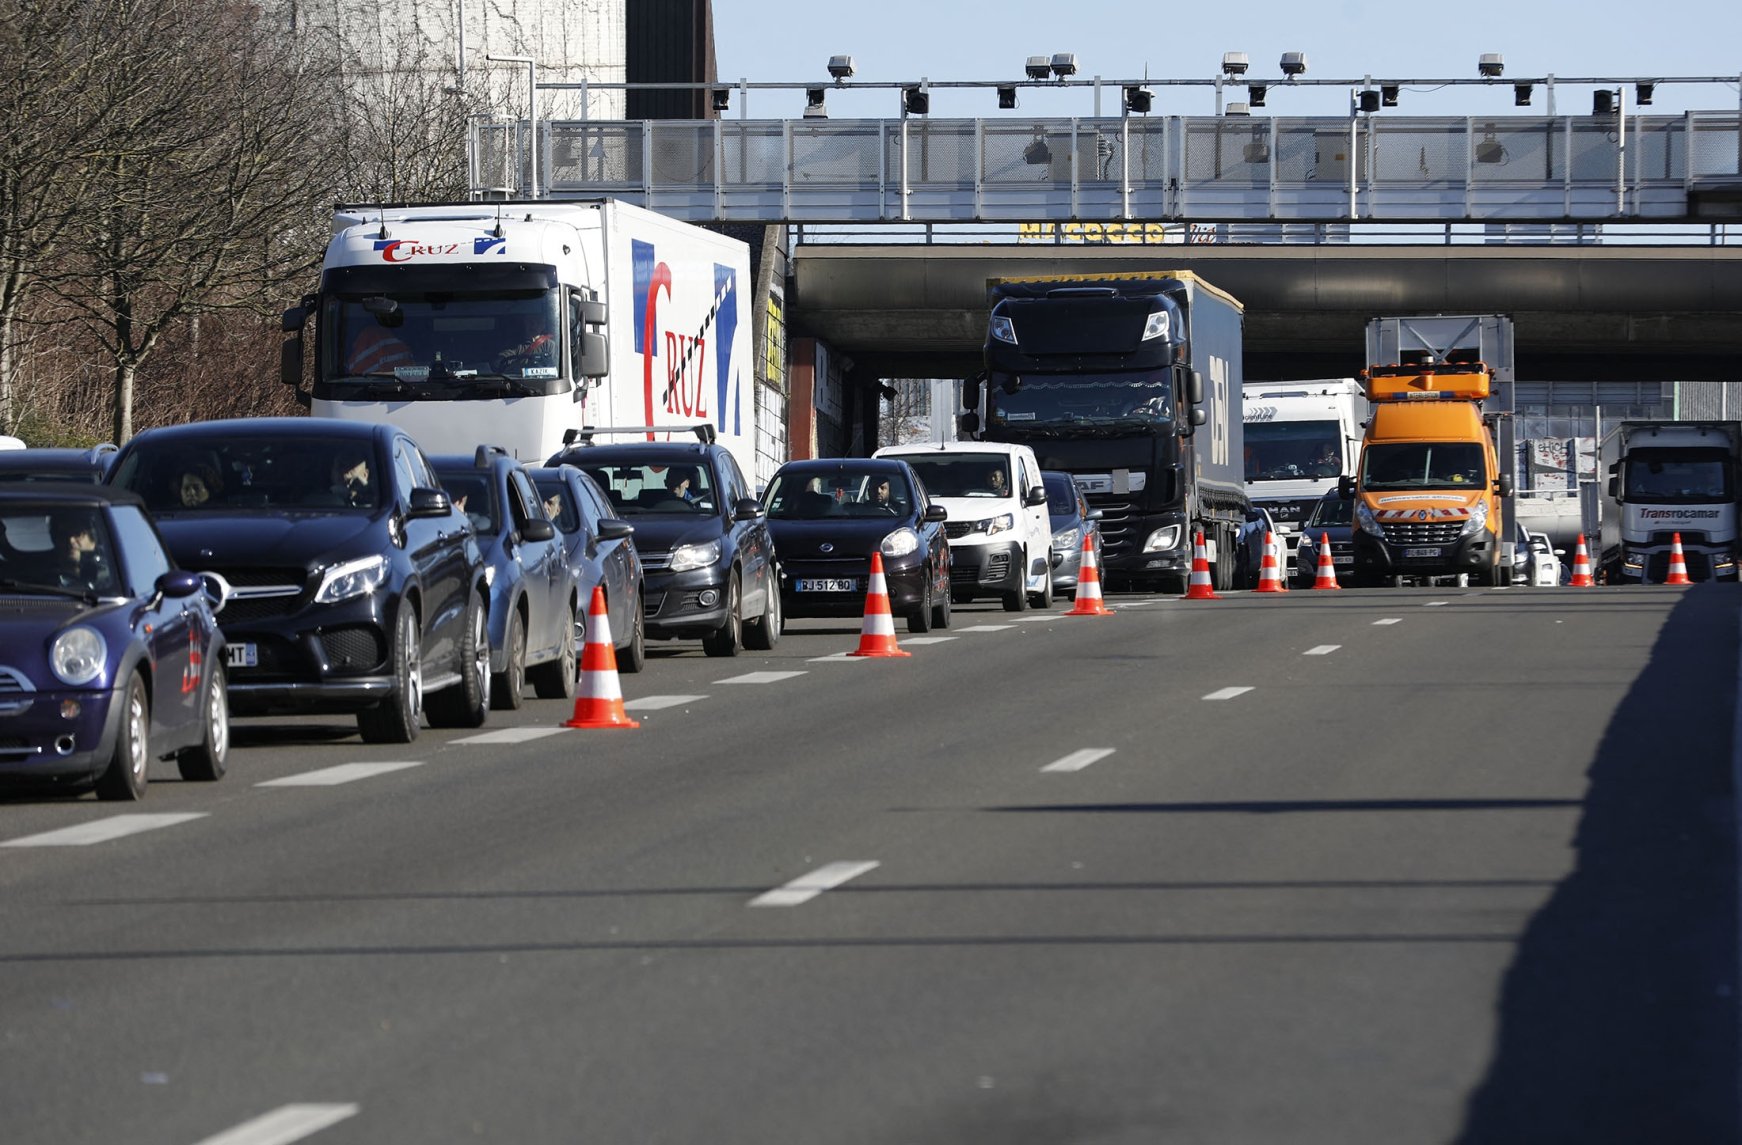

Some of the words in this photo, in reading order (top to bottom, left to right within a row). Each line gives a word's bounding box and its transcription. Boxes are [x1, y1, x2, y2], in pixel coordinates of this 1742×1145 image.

[383, 240, 460, 262] CRUZ
[1078, 481, 1104, 491] AF
[1268, 506, 1301, 514] MAN
[1640, 507, 1720, 519] Transrocamar
